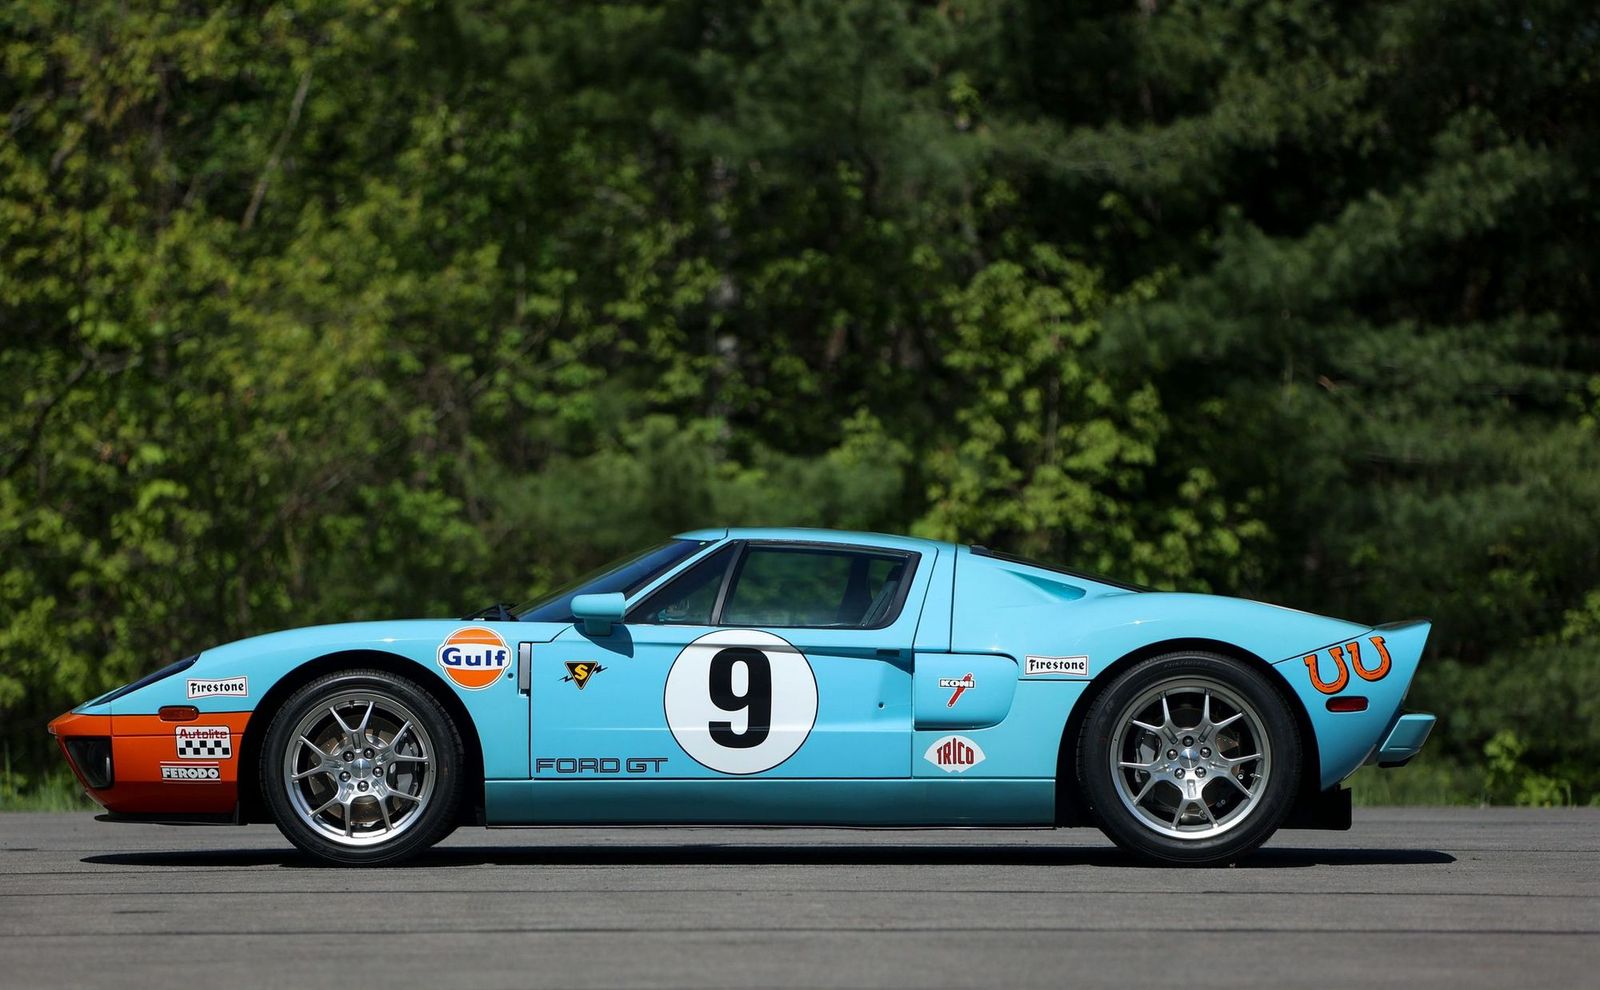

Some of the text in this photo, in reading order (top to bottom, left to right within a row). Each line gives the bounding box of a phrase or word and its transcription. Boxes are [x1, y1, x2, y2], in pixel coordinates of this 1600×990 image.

[442, 647, 506, 666] Gulf
[1029, 659, 1085, 672] Firestone
[190, 681, 244, 695] Firestone
[940, 680, 974, 688] KONI
[709, 647, 771, 748] 9
[179, 728, 228, 740] Autolite
[937, 738, 975, 765] TRICO
[535, 758, 668, 773] FORD GT
[162, 768, 219, 779] FERODO
